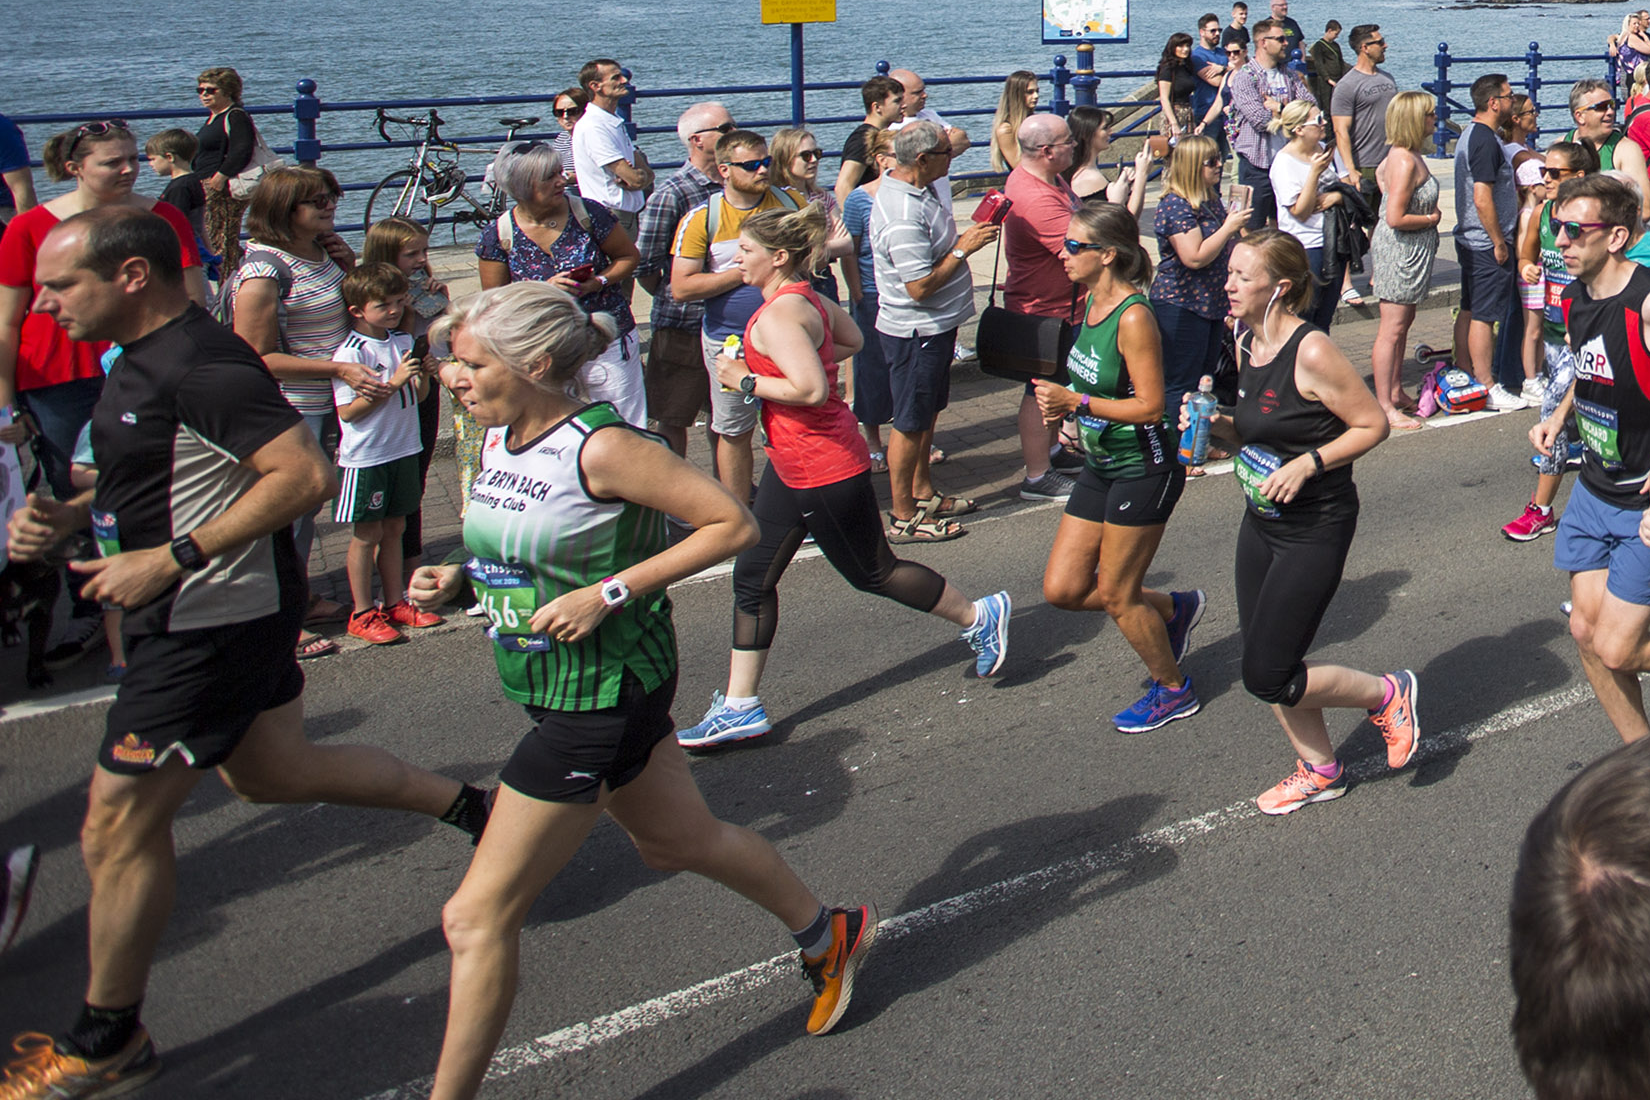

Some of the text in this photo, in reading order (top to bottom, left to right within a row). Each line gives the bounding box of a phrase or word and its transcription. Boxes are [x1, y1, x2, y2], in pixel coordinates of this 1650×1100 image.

[1066, 358, 1099, 386] UNNERS
[1581, 418, 1608, 443] RICHARD
[487, 469, 520, 492] BRYN
[516, 475, 552, 502] BACH
[502, 497, 527, 512] Club
